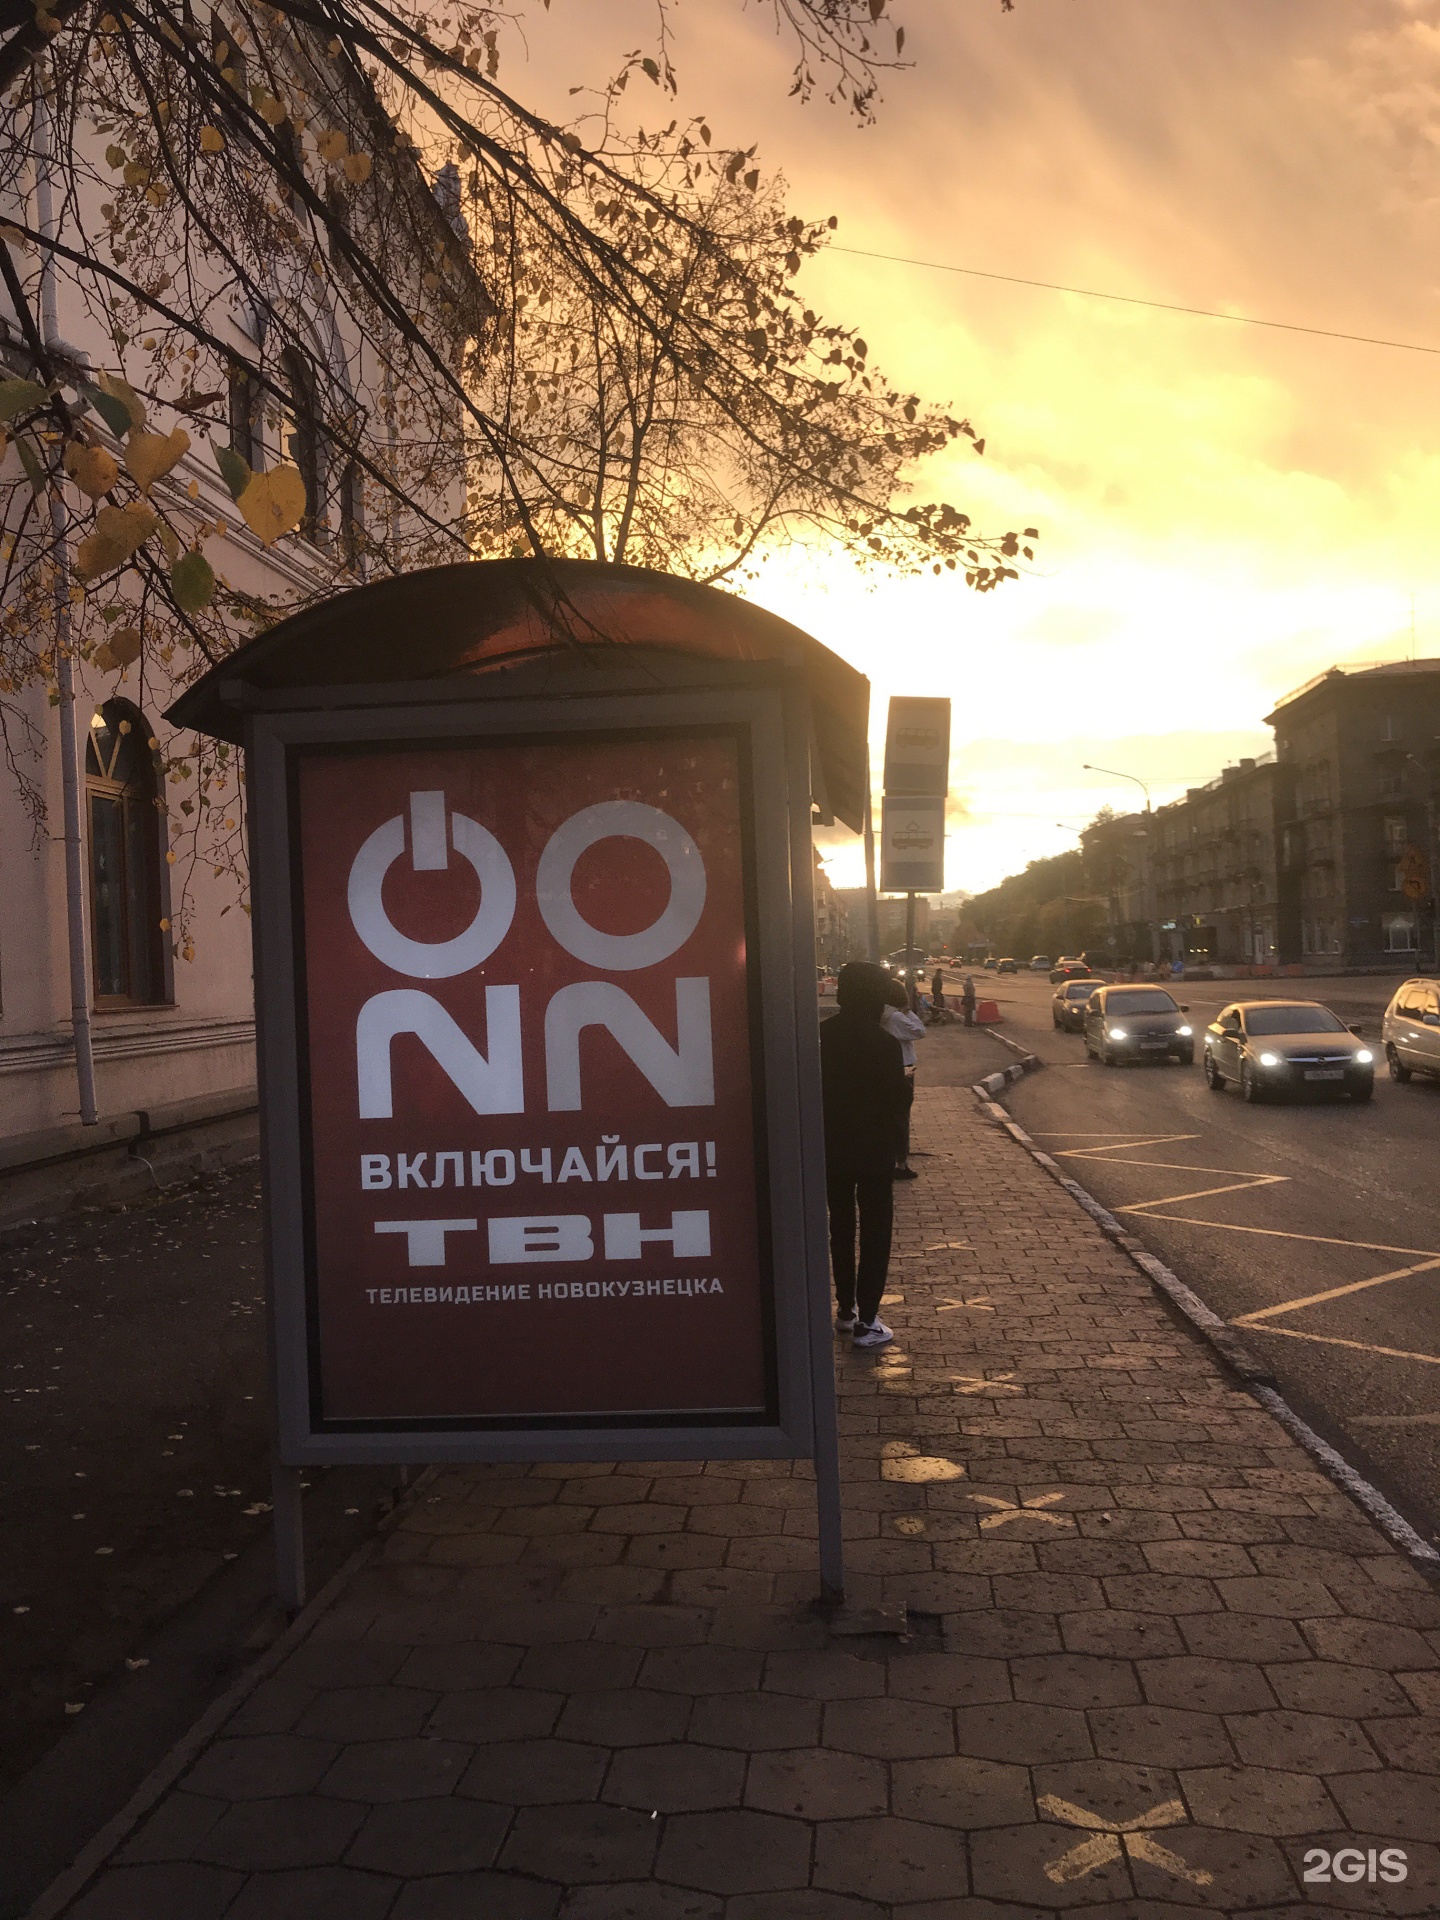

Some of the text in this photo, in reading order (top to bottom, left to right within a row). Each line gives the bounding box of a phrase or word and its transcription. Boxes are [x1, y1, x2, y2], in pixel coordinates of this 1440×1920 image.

[360, 1134, 718, 1190] ВКЛЮЧАЙСЯ!
[374, 1209, 712, 1267] ТВН
[365, 1277, 724, 1305] ТЕЛЕВИДЕНИЕ НОВОКУЗНЕЦКА
